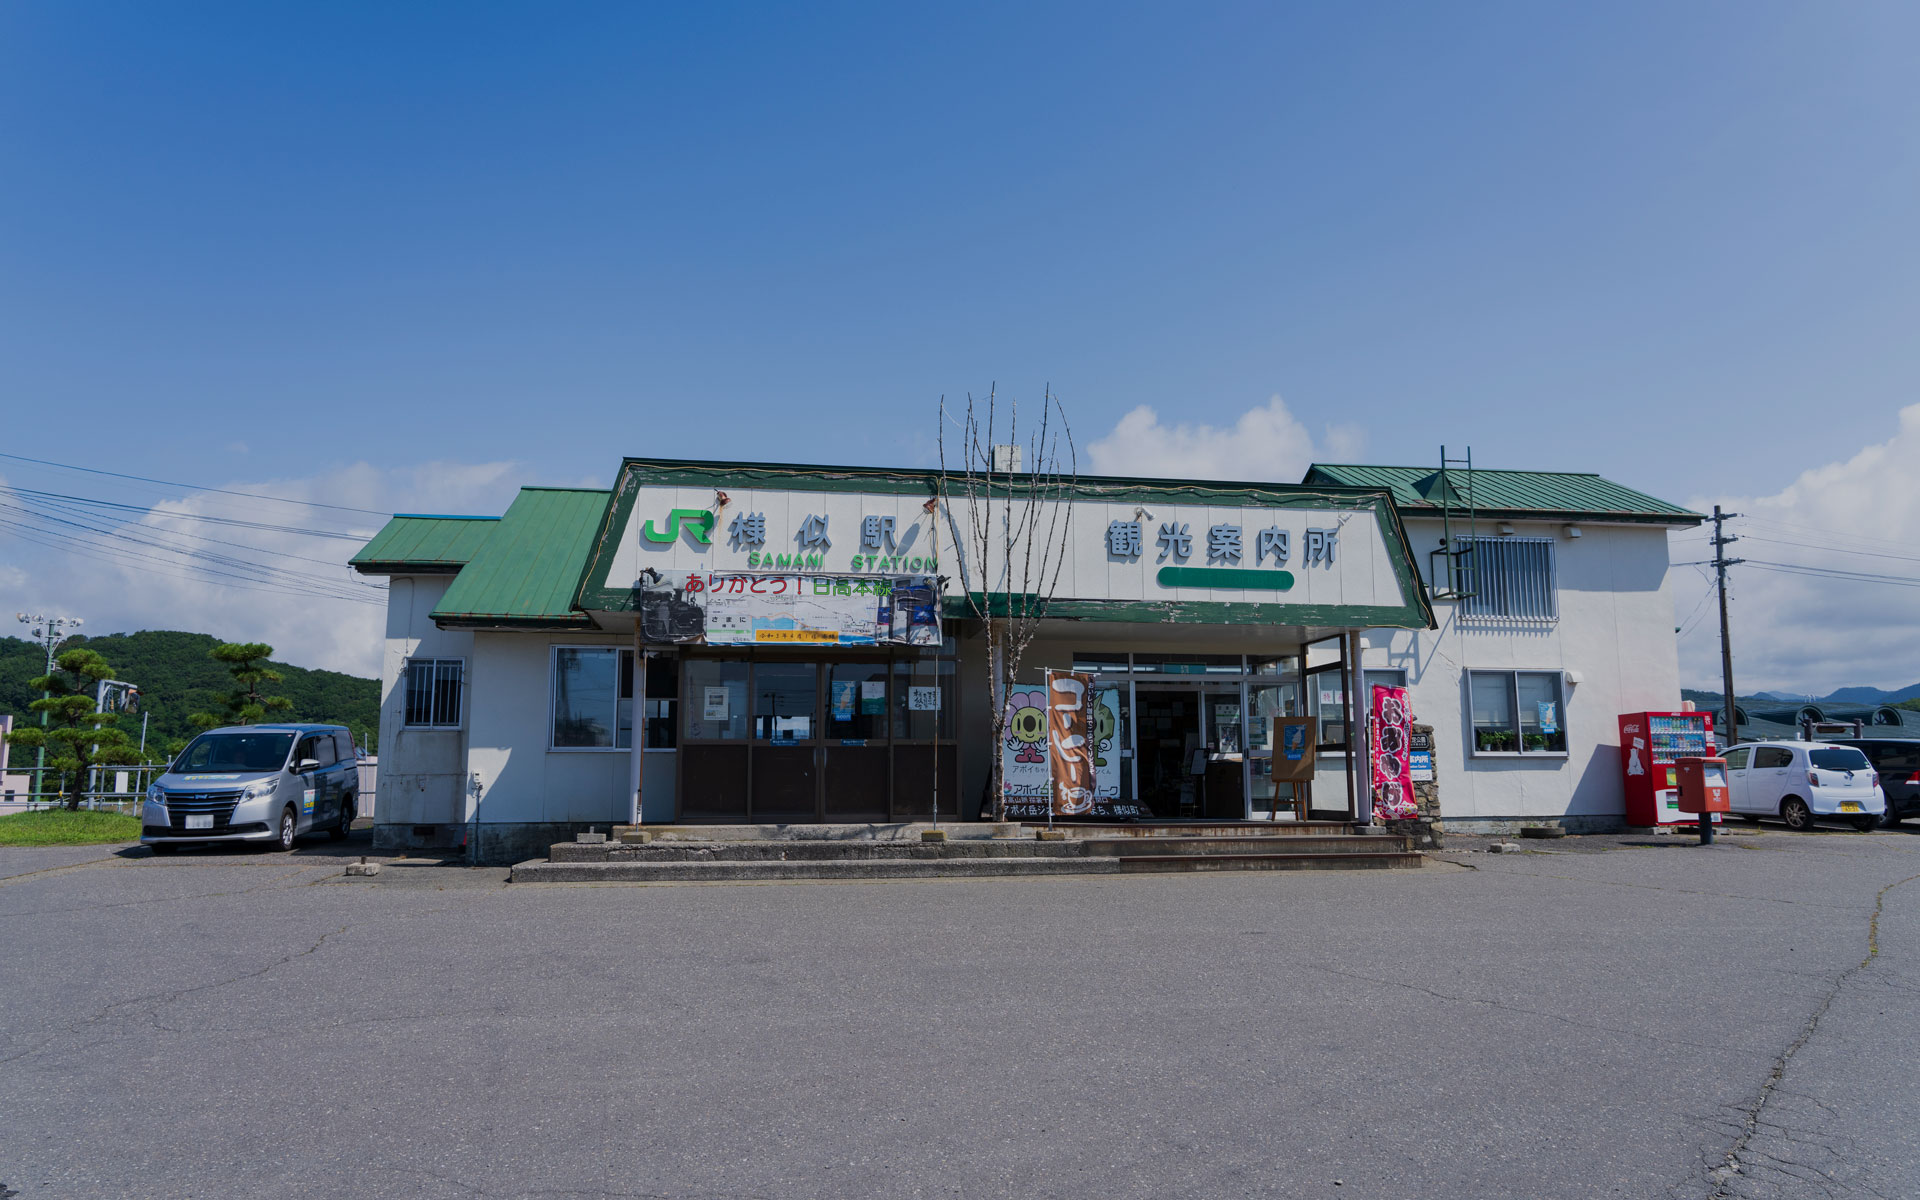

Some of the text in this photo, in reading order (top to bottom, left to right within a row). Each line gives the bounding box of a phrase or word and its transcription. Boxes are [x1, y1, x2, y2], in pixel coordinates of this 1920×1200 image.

[645, 508, 714, 544] JR
[732, 511, 897, 549] 様似駅
[1109, 521, 1339, 562] 観光案内所
[749, 551, 939, 570] SAMANI STATION
[1052, 678, 1086, 783] コーヒー
